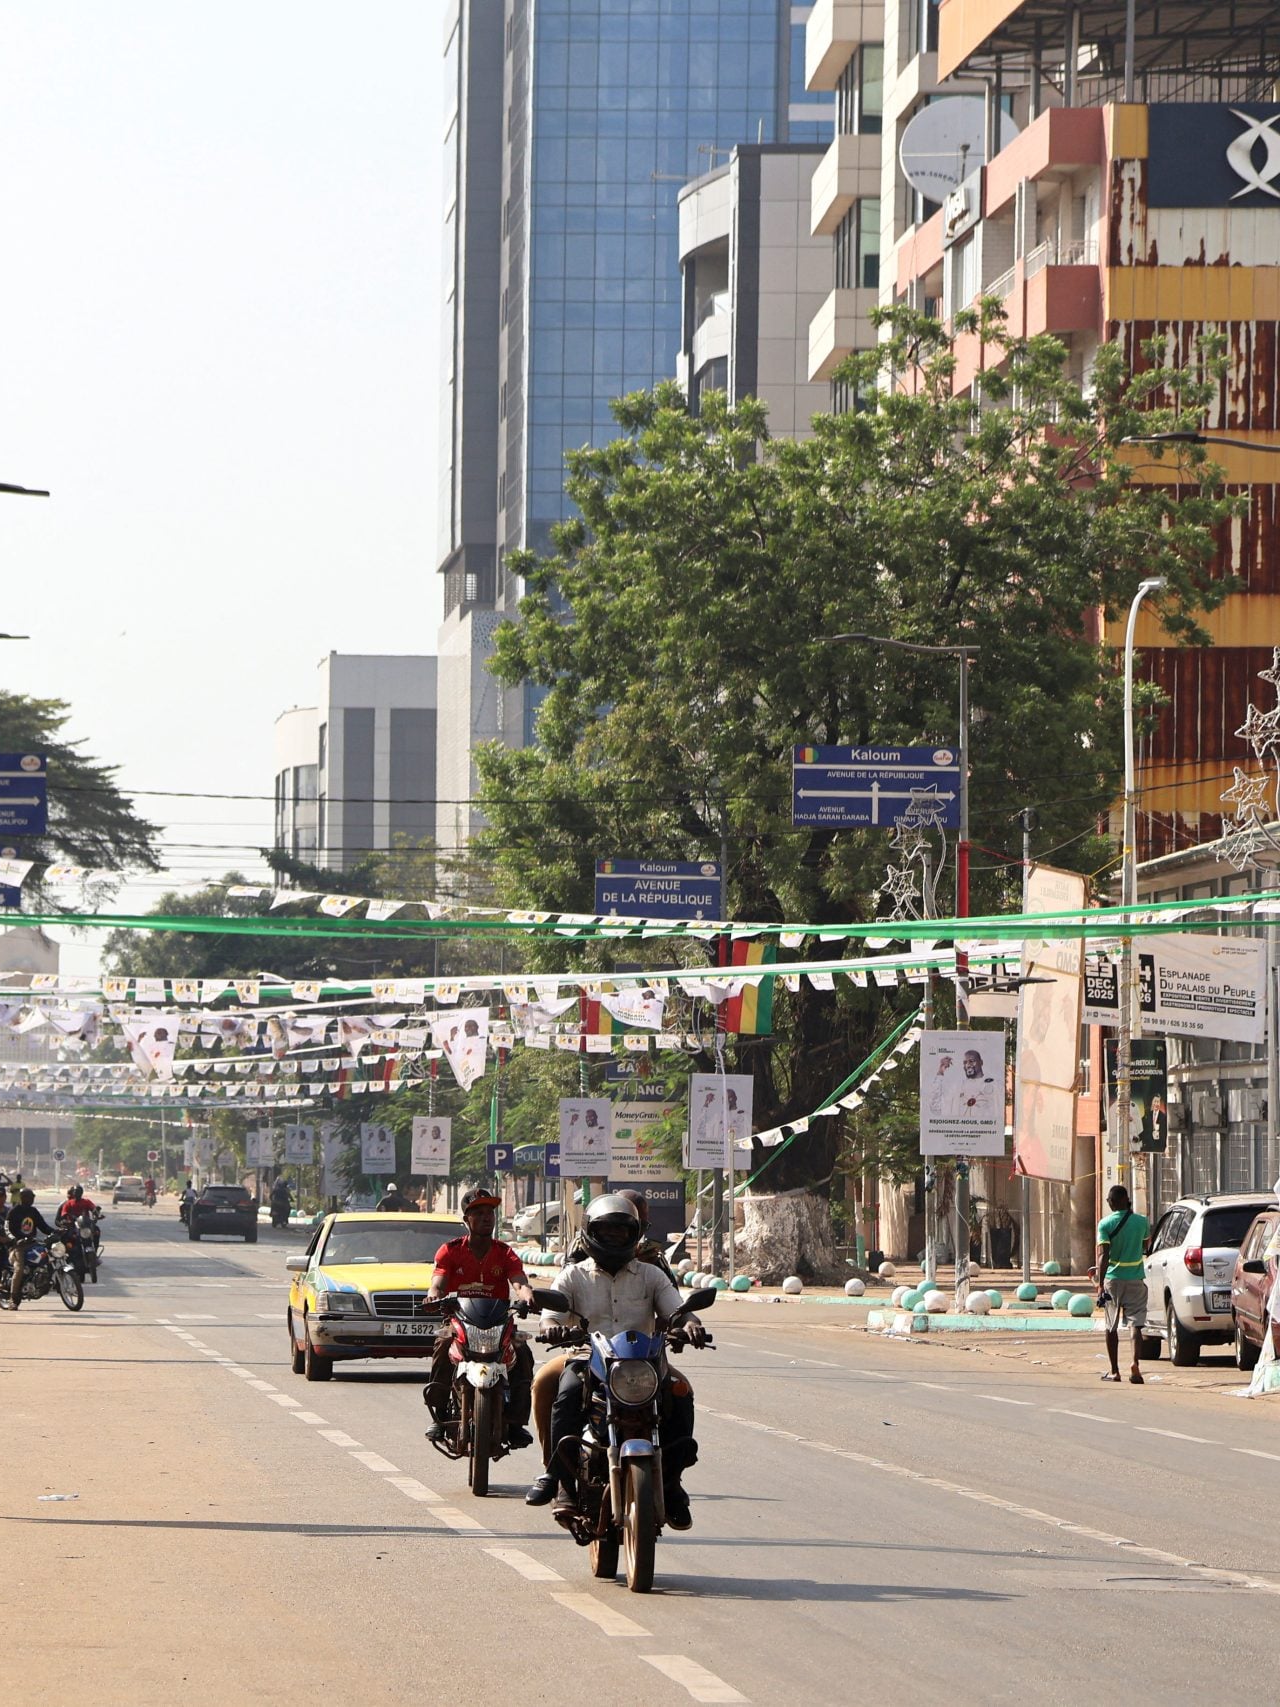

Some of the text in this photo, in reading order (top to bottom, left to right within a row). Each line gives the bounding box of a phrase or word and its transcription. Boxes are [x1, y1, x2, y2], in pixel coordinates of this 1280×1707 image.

[851, 749, 901, 762] Kaloum
[827, 770, 925, 780] AVENUE DE LA RÉPUBLIQUE
[794, 813, 870, 822] HADJA SARAN DARABA
[639, 863, 677, 873] Kaloum
[634, 880, 681, 891] AVENUE
[602, 892, 713, 906] DE LA RÉPUBLIQUE
[1087, 978, 1116, 990] DEC.
[1176, 982, 1206, 994] PALAIS
[1208, 986, 1220, 995] DU
[1087, 988, 1114, 1001] 2025
[494, 1149, 508, 1166] P
[645, 1188, 679, 1200] Social
[395, 1323, 434, 1335] AZ 5872
